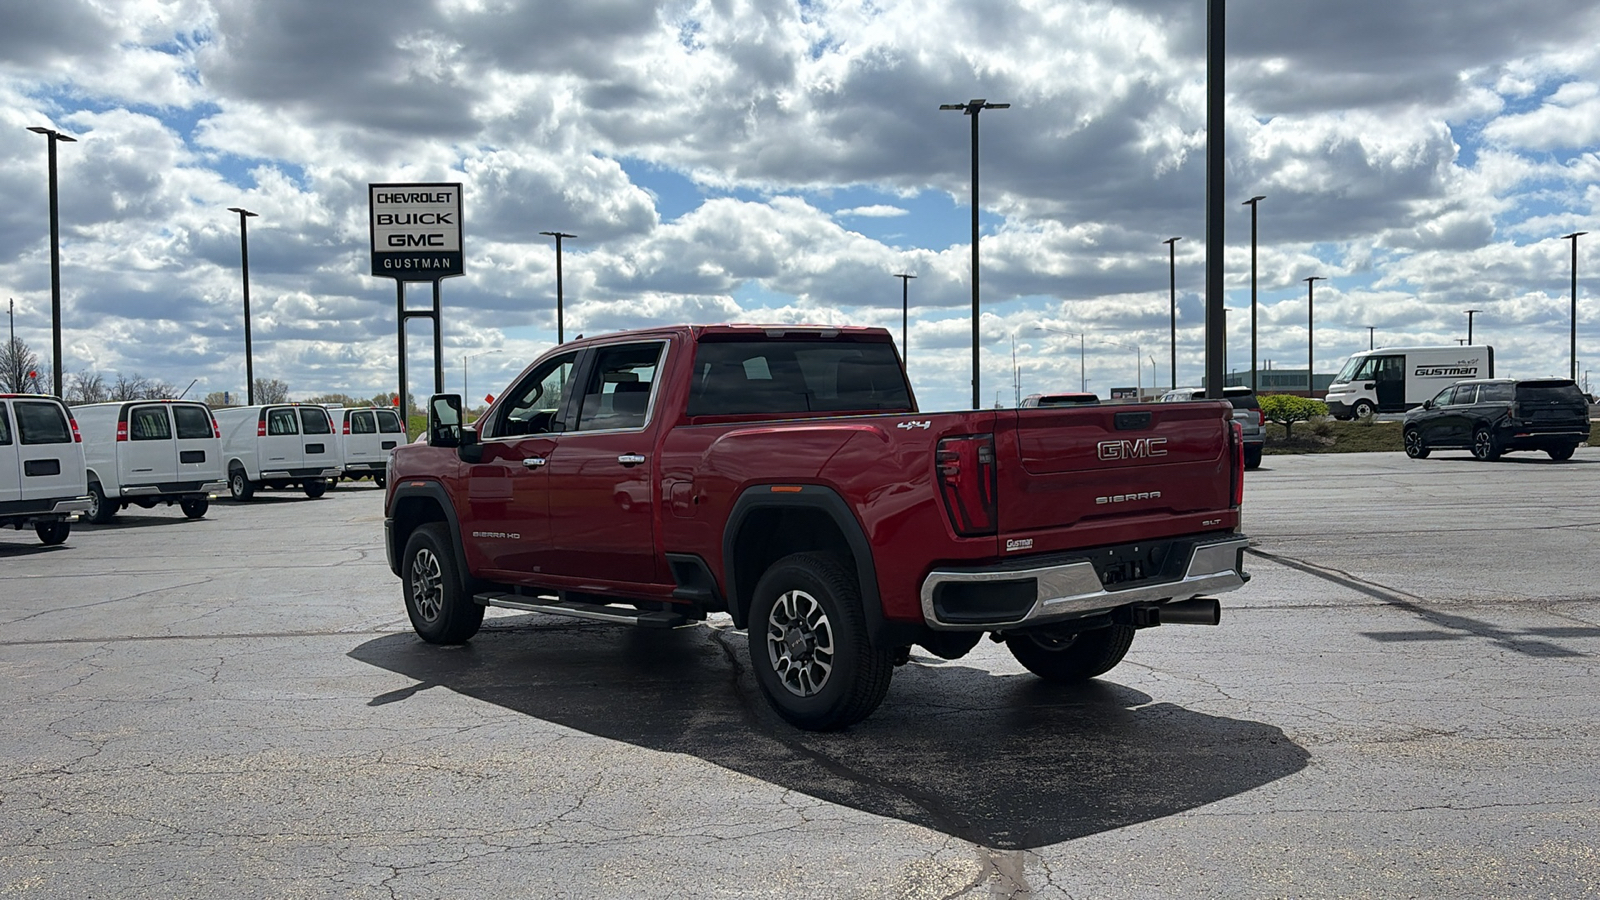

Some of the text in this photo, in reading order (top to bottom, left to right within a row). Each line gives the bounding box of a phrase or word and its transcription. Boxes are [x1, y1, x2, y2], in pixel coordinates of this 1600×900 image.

[377, 192, 452, 204] CHEVROLET
[377, 212, 454, 225] BUICK
[387, 233, 444, 247] GMC
[383, 257, 450, 269] GUSTMAN
[1097, 437, 1168, 461] GMC
[1095, 491, 1161, 505] SIERRA
[1202, 518, 1222, 526] SLT
